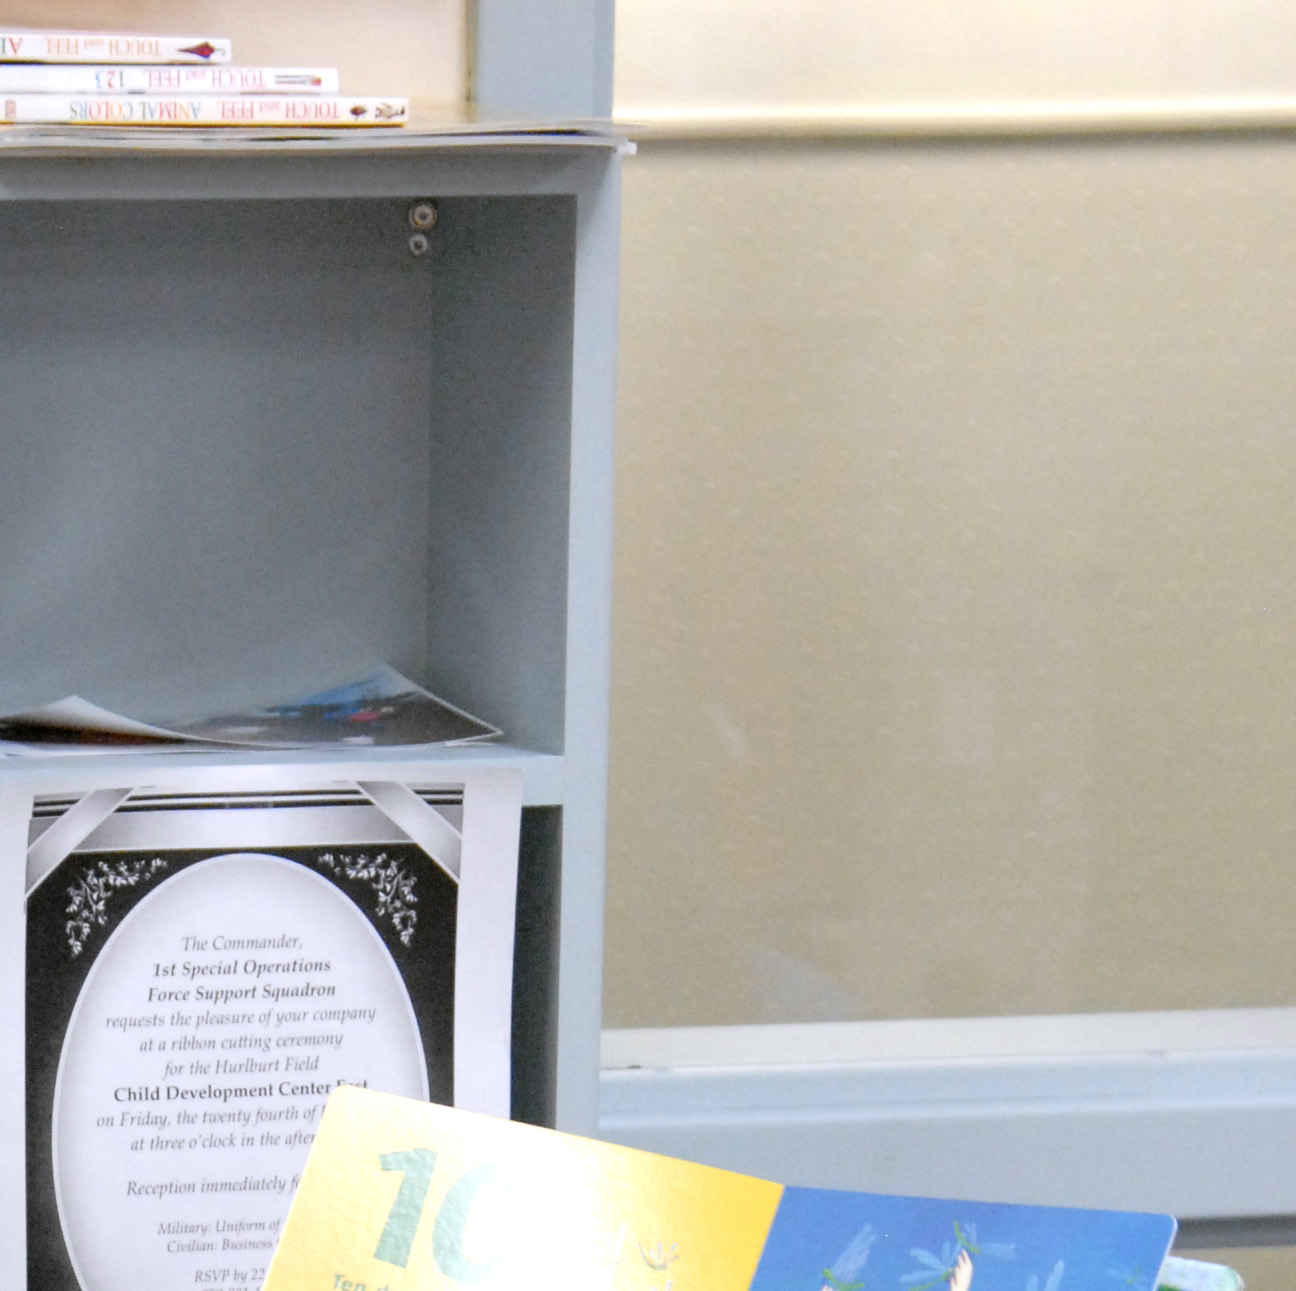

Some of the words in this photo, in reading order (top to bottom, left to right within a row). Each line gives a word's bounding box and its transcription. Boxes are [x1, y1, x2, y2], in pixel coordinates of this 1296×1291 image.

[43, 38, 80, 56] FEEL
[109, 39, 163, 56] TOUCH
[146, 69, 182, 88] FEEL
[211, 69, 265, 88] TOUCH
[69, 100, 135, 118] COLORS
[140, 101, 202, 118] ANIMAL
[220, 101, 254, 119] FEEL
[285, 101, 341, 119] TOUCH
[182, 936, 209, 951] The
[212, 933, 304, 952] Commander,
[153, 963, 178, 978] 1st
[181, 960, 239, 980] Special
[243, 958, 332, 979] Operations
[147, 986, 191, 1003] Force
[195, 984, 257, 1005] Support
[262, 981, 337, 1003] Squadron
[105, 1012, 166, 1032] requests
[170, 1011, 192, 1027] the
[195, 1009, 255, 1030] pleasure
[258, 1007, 275, 1027] of
[276, 1010, 310, 1027] your
[312, 1007, 377, 1026] company
[139, 1038, 154, 1052] at
[157, 1040, 167, 1052] a
[171, 1035, 217, 1052] ribbon
[220, 1034, 272, 1053] cutting
[276, 1032, 344, 1050] ceremony
[162, 1060, 185, 1081] for
[189, 1060, 212, 1076] the
[214, 1056, 281, 1076] Hurlburt
[284, 1055, 321, 1072] Field
[113, 1086, 161, 1102] Child
[165, 1084, 274, 1102] Development
[278, 1081, 332, 1098] Center
[96, 1116, 116, 1128] on
[119, 1111, 172, 1131] Friday,
[176, 1111, 198, 1126] the
[201, 1109, 252, 1127] twenty
[254, 1105, 300, 1126] fourth
[302, 1105, 318, 1125] of
[130, 1137, 145, 1152] at
[150, 1135, 186, 1151] three
[240, 1132, 255, 1148] in
[259, 1131, 282, 1147] the
[126, 1180, 197, 1199] Reception
[199, 1176, 287, 1194] immediately
[157, 1219, 213, 1237] Military:
[215, 1218, 267, 1236] Uniform
[166, 1237, 219, 1254] Civilian:
[221, 1237, 274, 1252] Business
[194, 1268, 231, 1284] RSVP
[233, 1268, 249, 1285] by
[251, 1268, 265, 1282] 22
